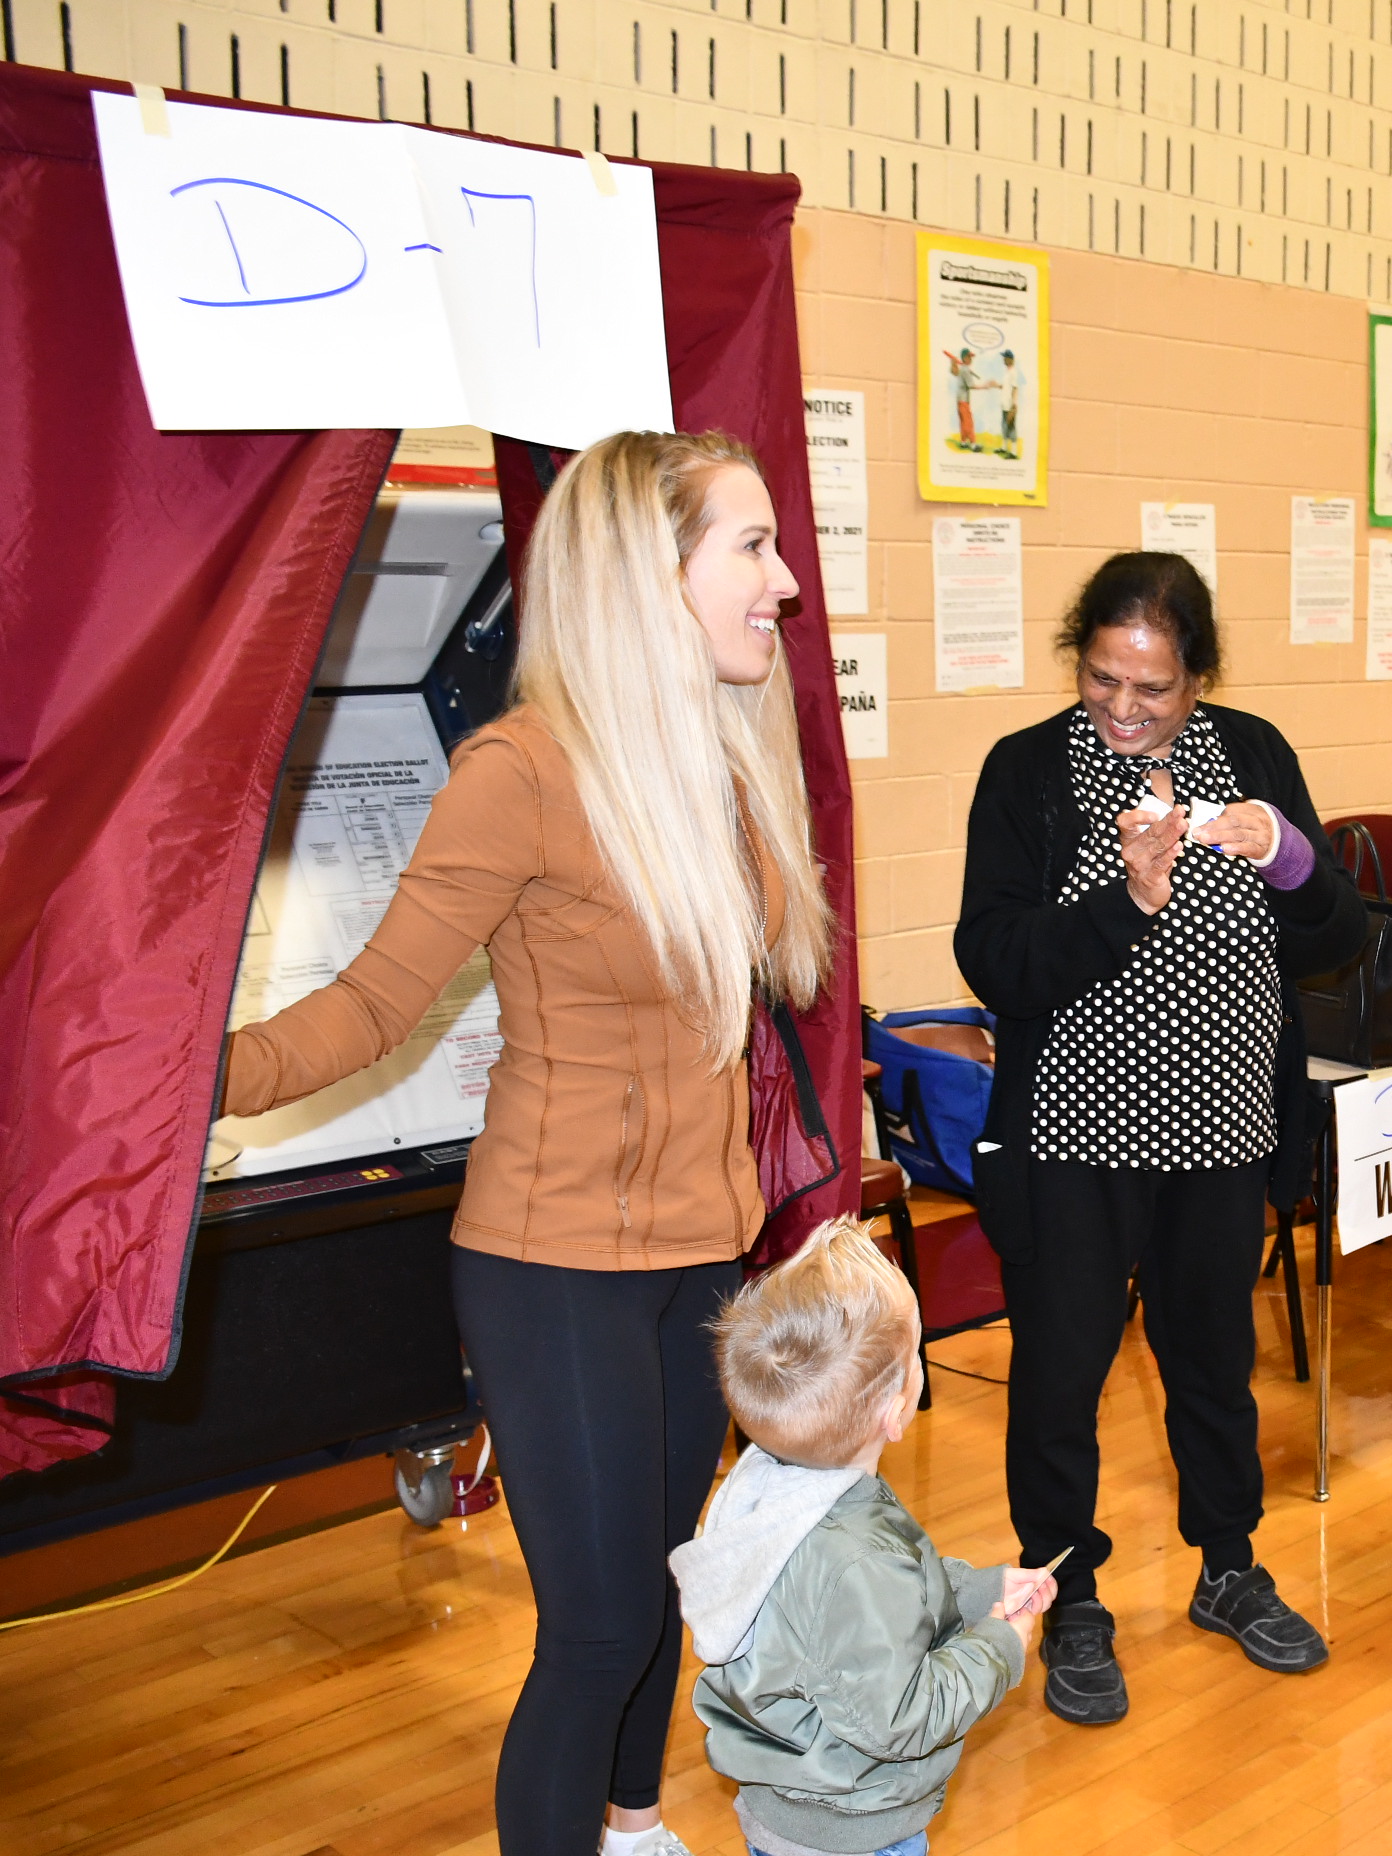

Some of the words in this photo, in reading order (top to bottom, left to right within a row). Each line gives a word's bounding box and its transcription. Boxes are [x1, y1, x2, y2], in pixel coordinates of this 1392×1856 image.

[803, 399, 853, 416] NOTICE
[335, 762, 373, 770] EDUCATION
[374, 760, 404, 768] ELECTION
[405, 759, 429, 767] BALLOT
